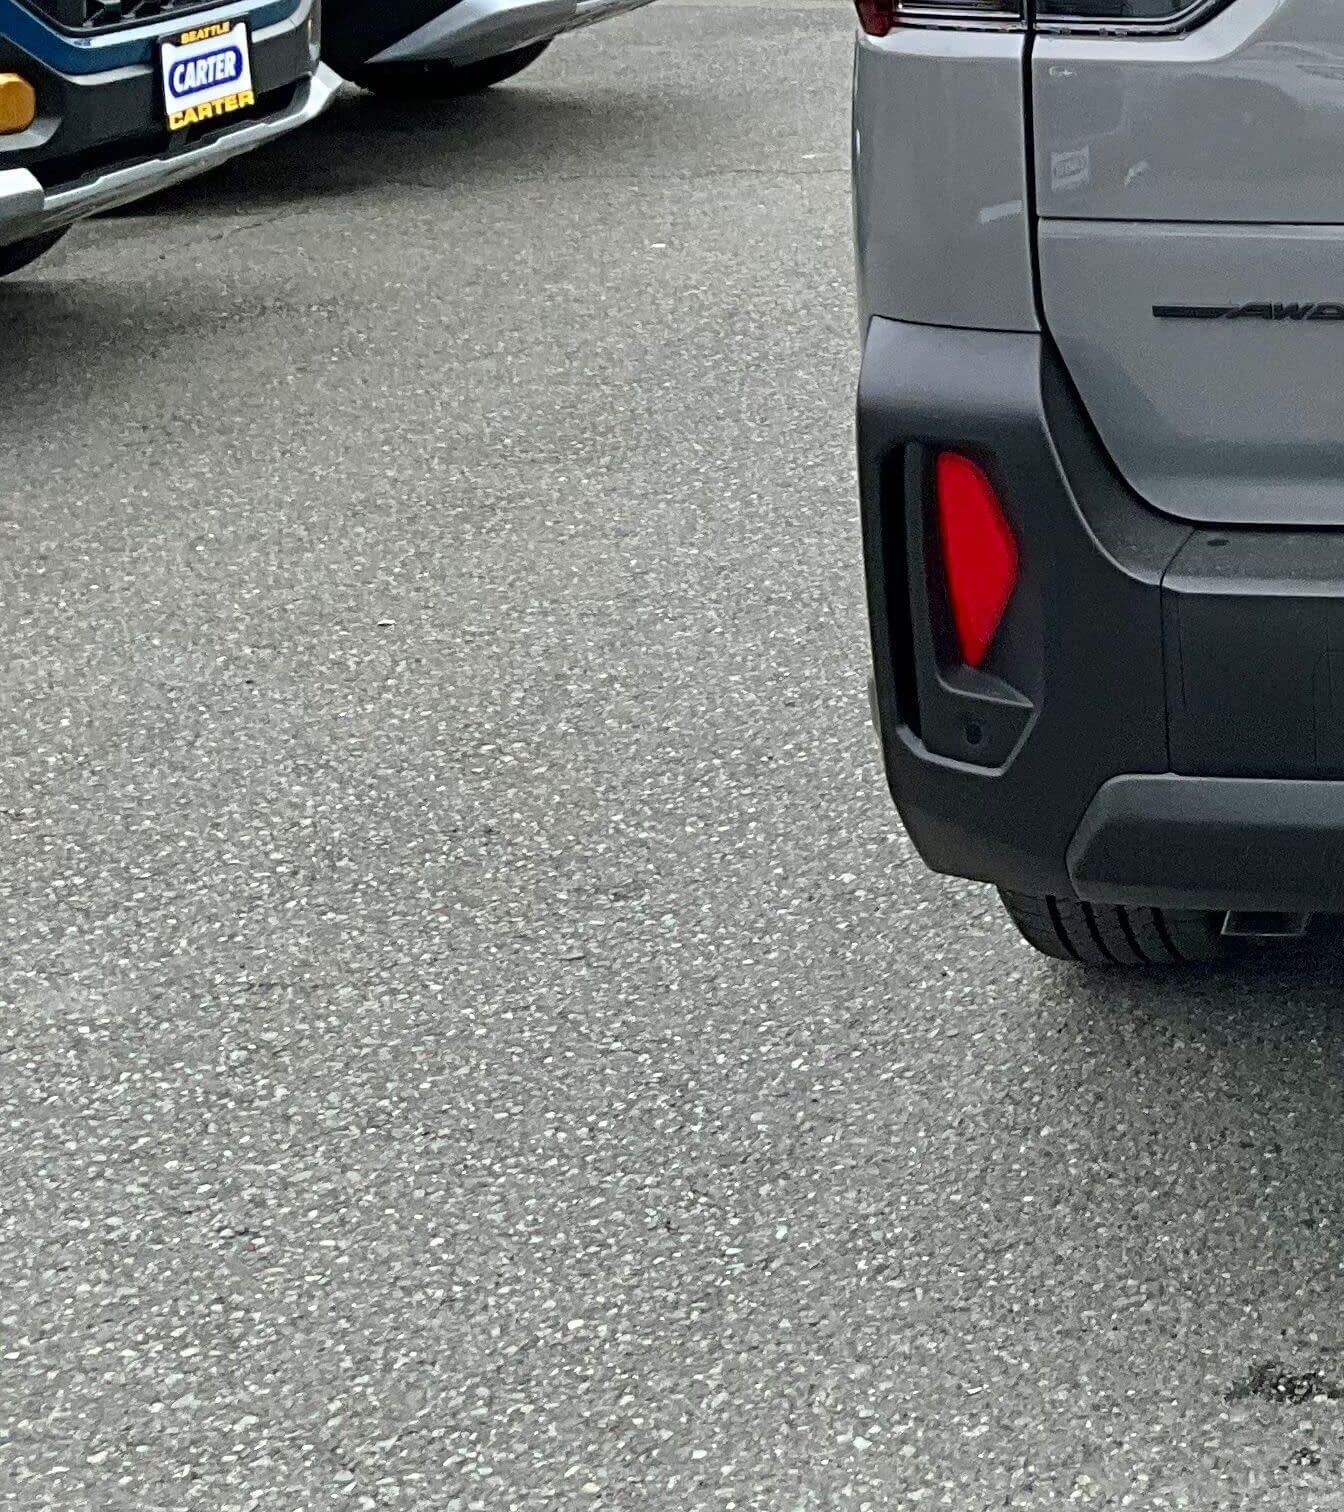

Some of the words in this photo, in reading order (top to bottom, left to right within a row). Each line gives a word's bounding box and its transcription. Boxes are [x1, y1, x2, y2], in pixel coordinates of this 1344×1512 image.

[181, 21, 230, 44] SEATTLE
[173, 51, 236, 93] CARTER
[169, 90, 255, 130] CARTER
